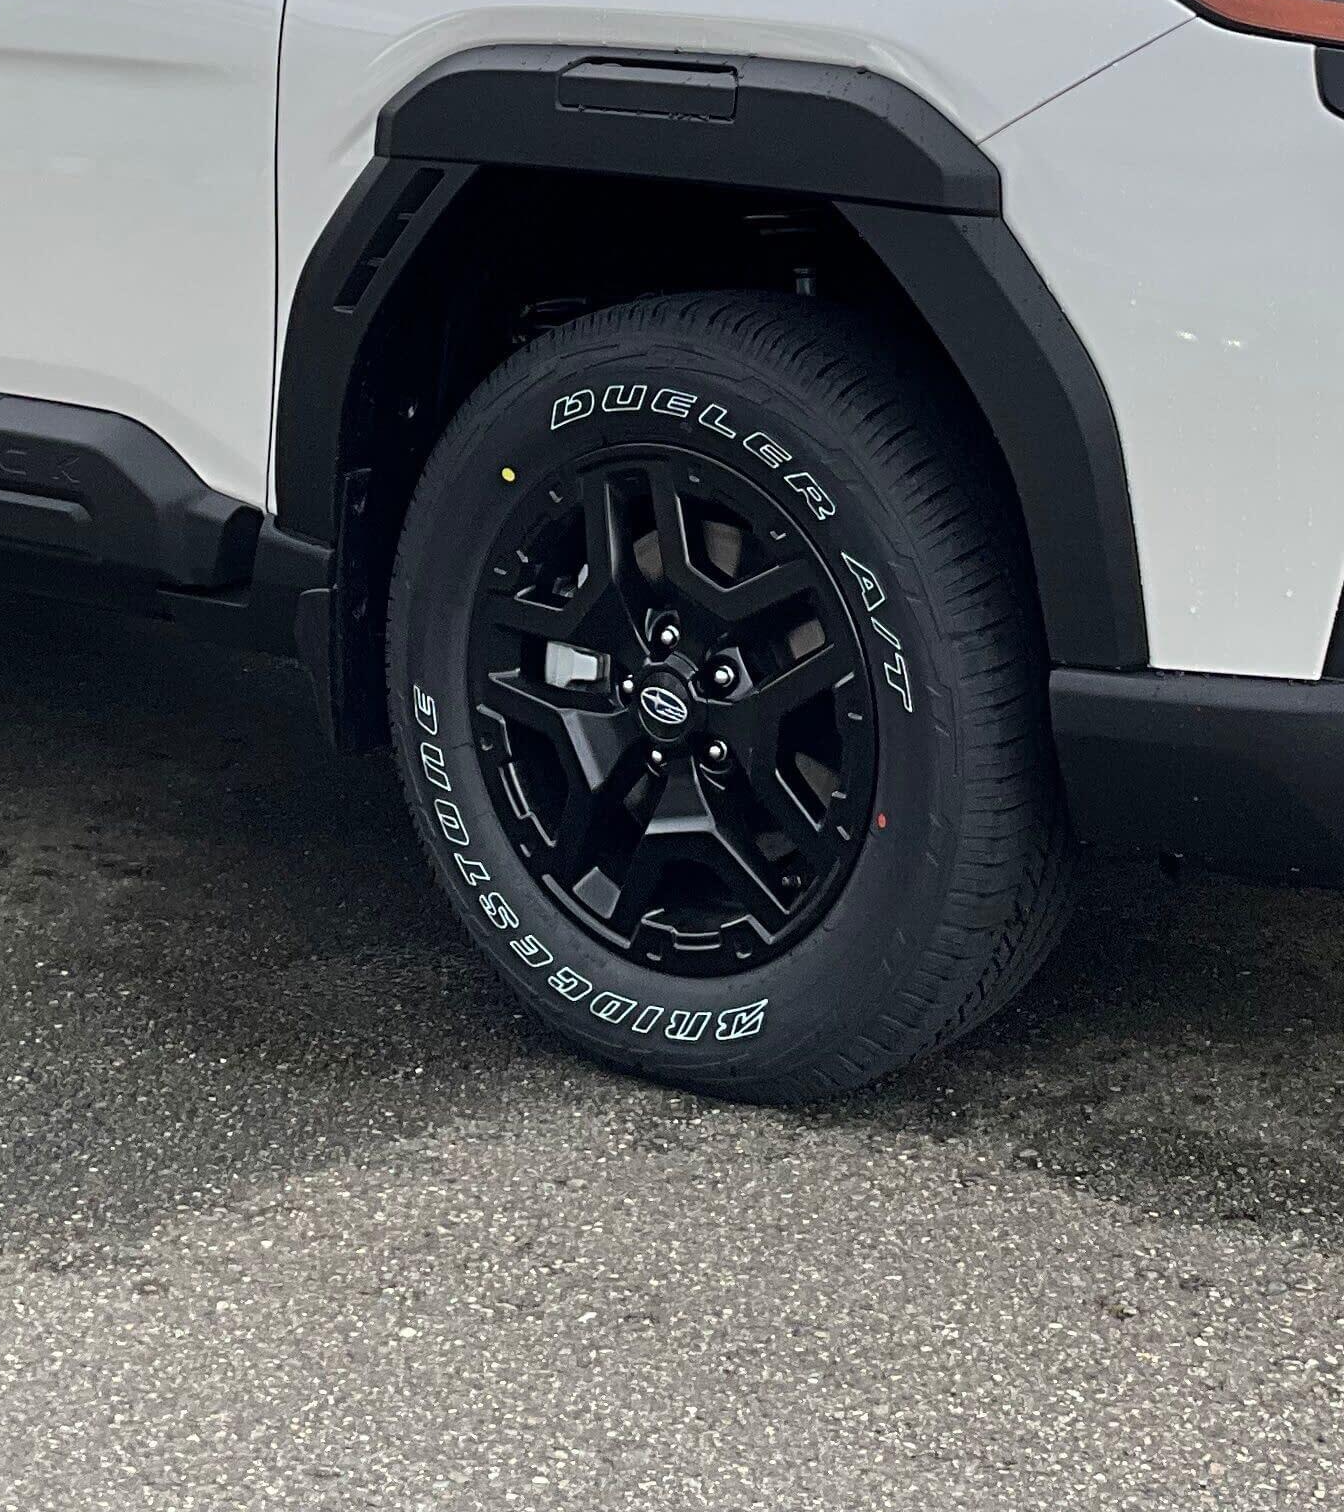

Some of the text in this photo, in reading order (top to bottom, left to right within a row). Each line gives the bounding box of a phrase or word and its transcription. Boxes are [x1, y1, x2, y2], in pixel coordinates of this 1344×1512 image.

[551, 385, 913, 713] DUELER A/T
[413, 684, 769, 1041] BRIDGESTONE
